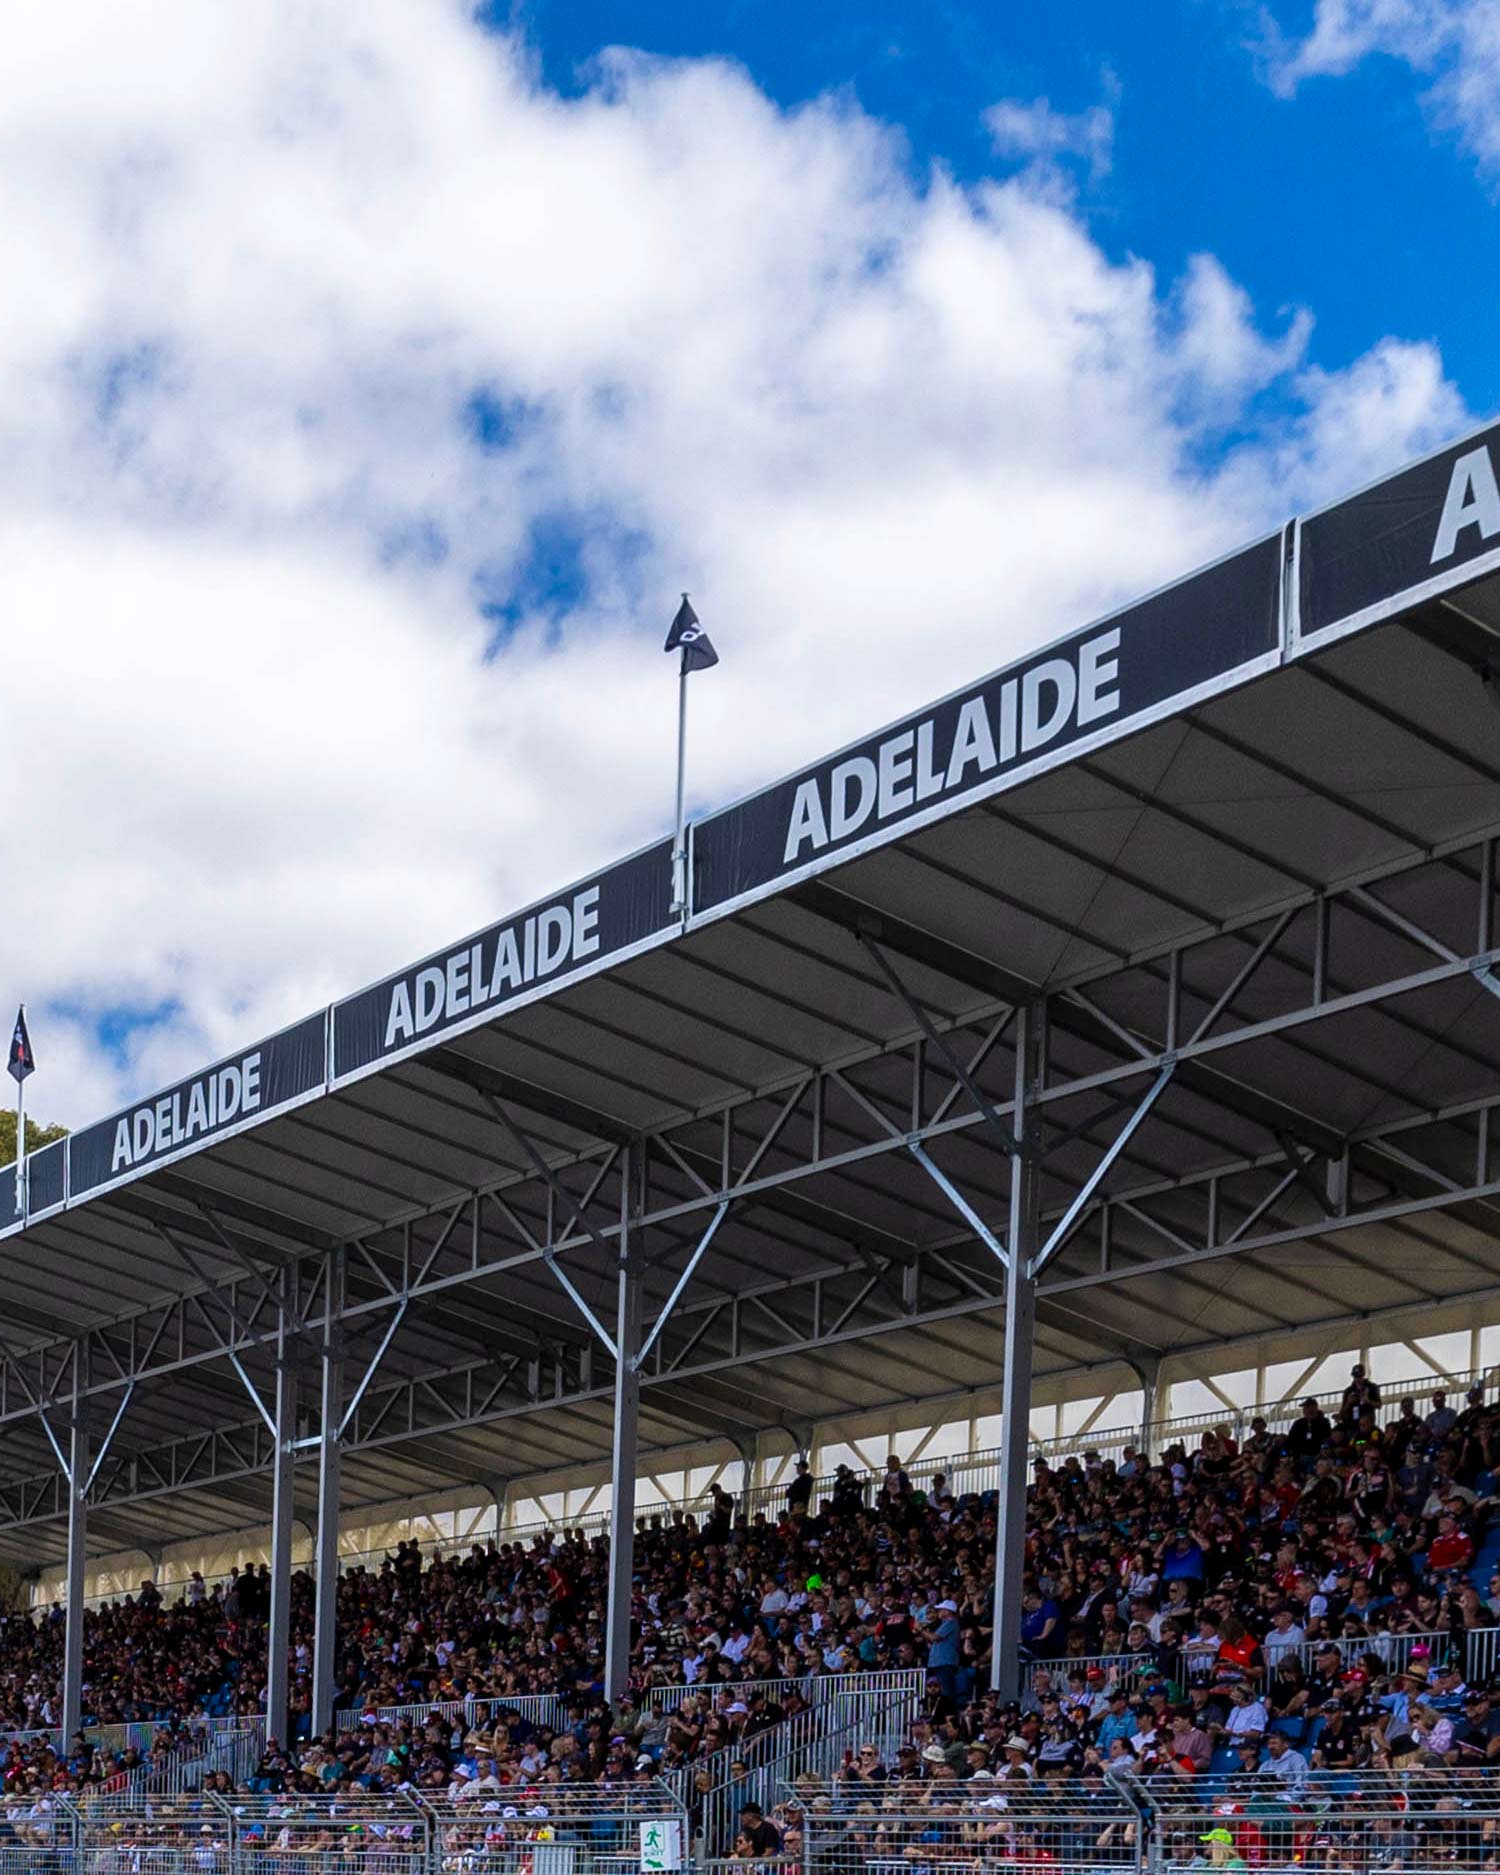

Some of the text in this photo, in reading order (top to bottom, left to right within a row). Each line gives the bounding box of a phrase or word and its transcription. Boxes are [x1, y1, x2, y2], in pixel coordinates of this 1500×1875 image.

[783, 627, 1120, 865] ADELAIDE
[383, 885, 600, 1047] ADELAIDE
[111, 1051, 261, 1172] ADELAIDE
